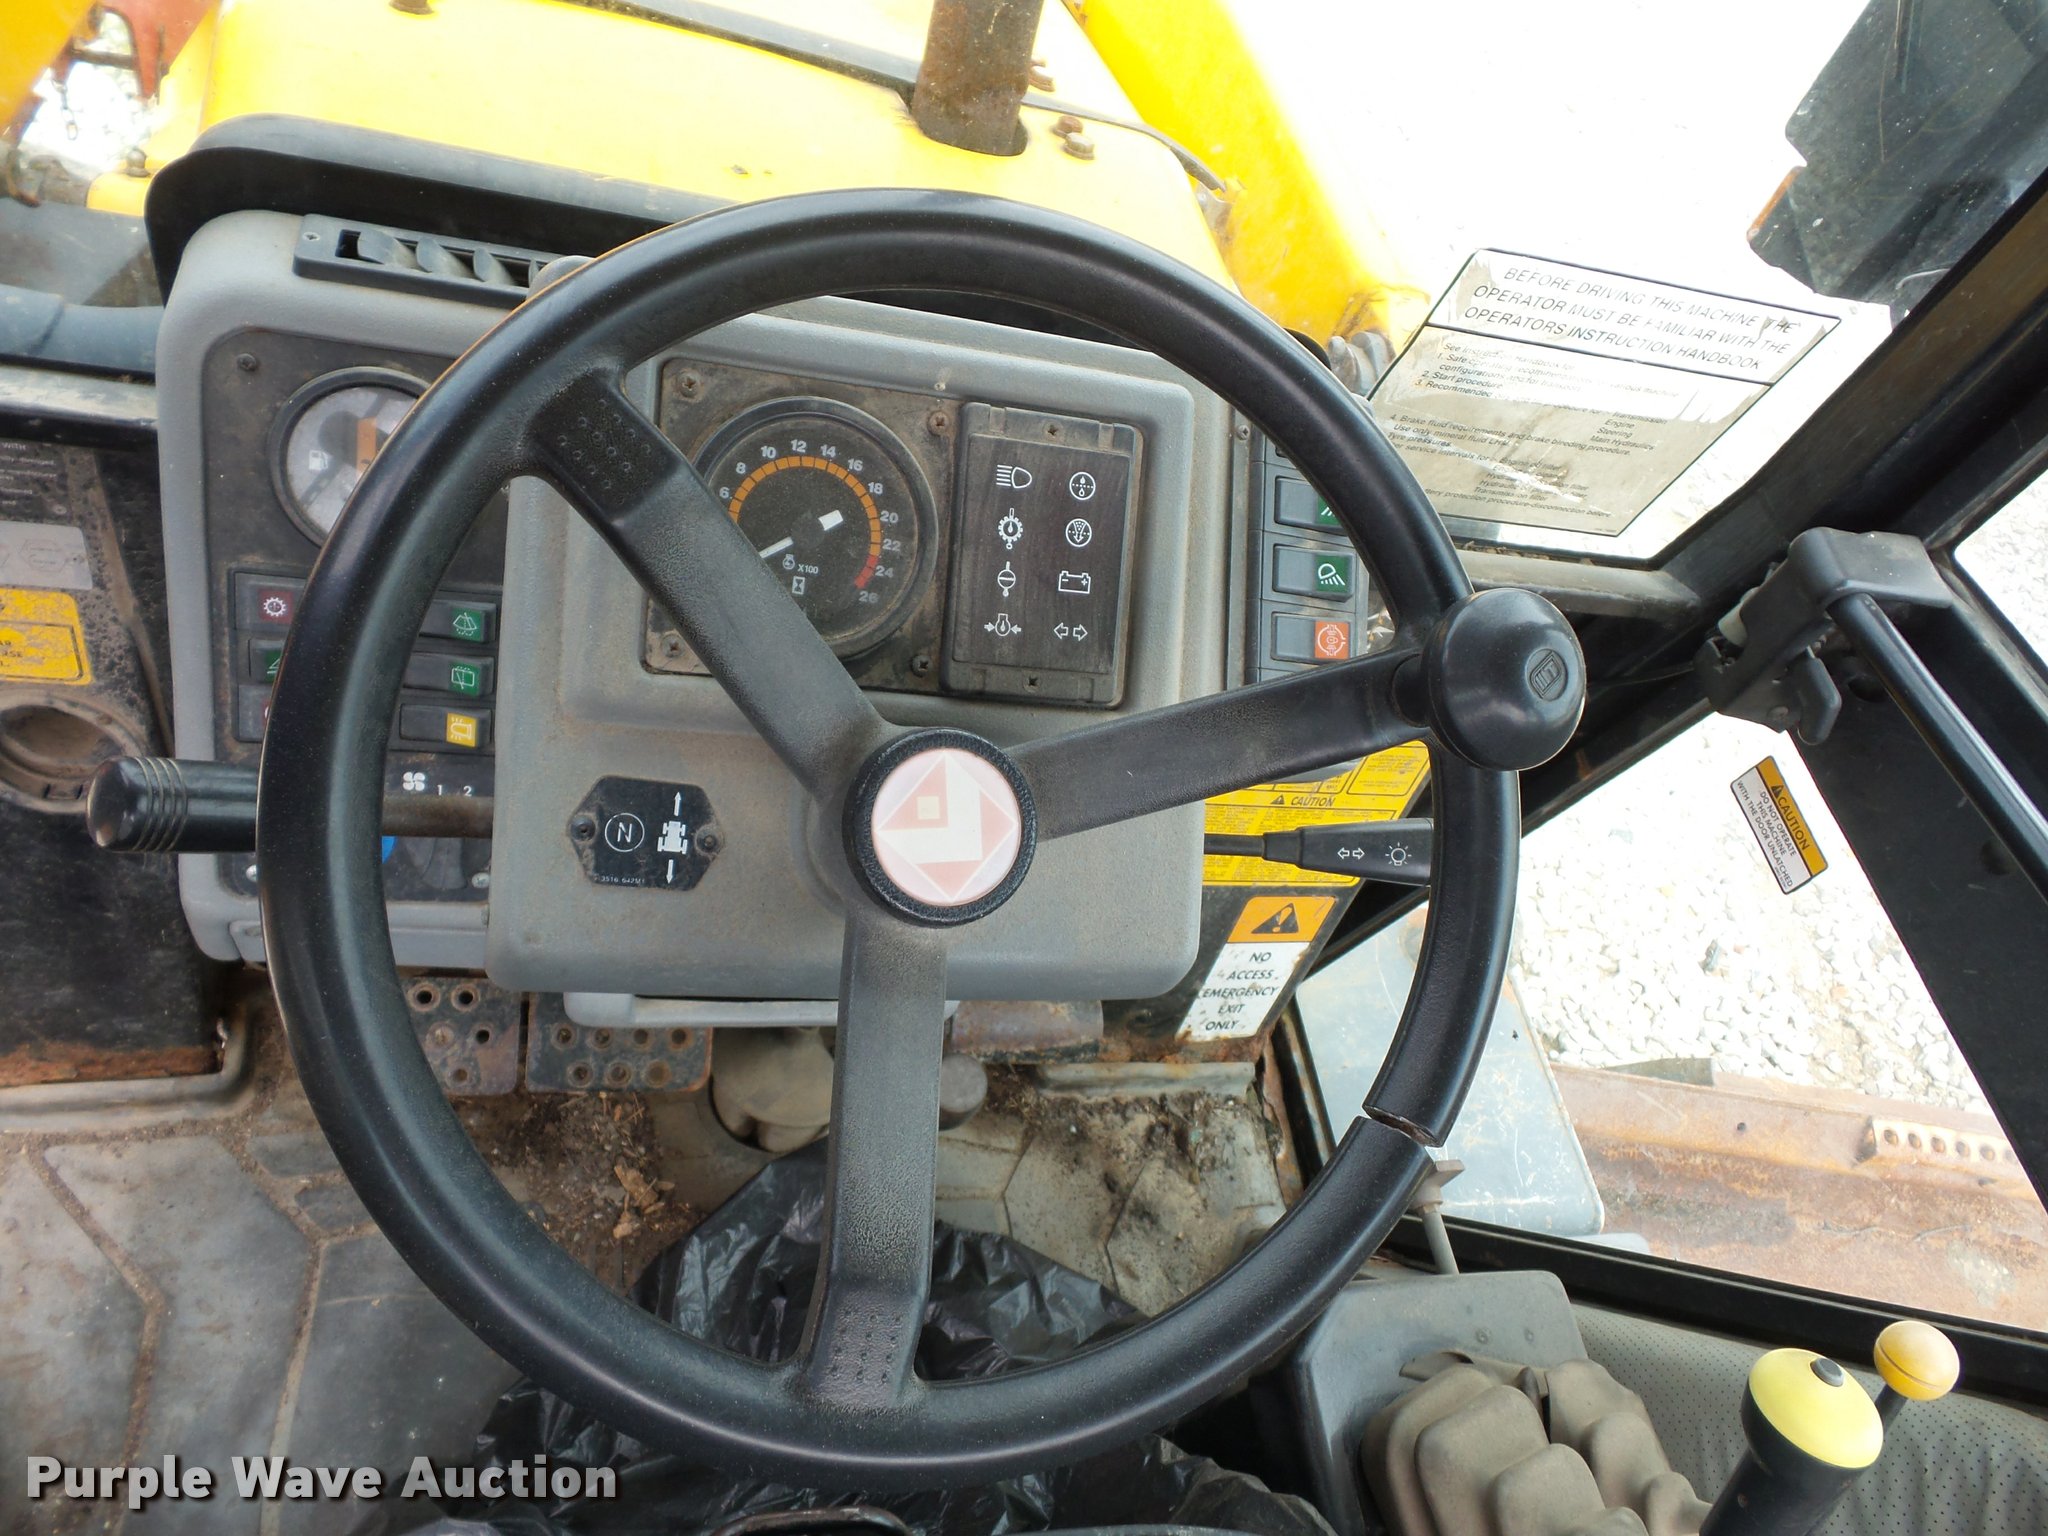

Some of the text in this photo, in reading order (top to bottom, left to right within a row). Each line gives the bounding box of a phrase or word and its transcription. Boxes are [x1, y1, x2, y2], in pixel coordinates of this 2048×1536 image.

[1504, 267, 1799, 334] BEFORE DRIVING THIS MACHINE THE
[1473, 285, 1792, 355] OPERATOR MUST BE FAMILIAR WITH THE
[1464, 306, 1762, 370] OPERATORS INSTRUCTION HANDBOOK
[1443, 342, 1462, 352] See
[1446, 354, 1468, 364] Safe
[1432, 371, 1456, 382] Start
[1455, 376, 1504, 390] procedure
[1400, 415, 1427, 425] Brake
[1448, 423, 1507, 438] requirements
[1604, 418, 1636, 430] Engine
[1393, 423, 1411, 432] Use
[1412, 427, 1431, 437] only
[1433, 430, 1467, 441] mineral
[1597, 426, 1633, 439] Steering
[761, 445, 777, 459] 10
[791, 439, 807, 453] 12
[820, 444, 837, 458] 14
[1406, 444, 1438, 454] service
[1438, 449, 1475, 460] intervals
[735, 462, 746, 474] 8
[847, 458, 863, 472] 16
[719, 487, 730, 499] 6
[868, 482, 884, 495] 18
[880, 511, 899, 524] 20
[883, 539, 900, 551] 22
[875, 565, 894, 578] 24
[858, 591, 879, 603] 26
[437, 784, 473, 797] 1 2
[1290, 795, 1336, 807] CAUTION
[1756, 801, 1768, 821] THIS
[1765, 820, 1786, 855] MACHINE
[1760, 791, 1770, 805] DO
[1766, 803, 1779, 822] NOT
[1776, 822, 1797, 857] OPERATE
[1778, 796, 1810, 850] CAUTION
[617, 822, 633, 843] N
[1737, 780, 1750, 801] WITH
[1747, 801, 1758, 816] THE
[1755, 816, 1769, 841] DOOR
[1767, 840, 1794, 887] UNLATCHED
[1249, 952, 1272, 963] NO
[1226, 969, 1275, 980] ACCESS
[1202, 986, 1280, 999] EMERGENCY
[1217, 1004, 1246, 1014] EXIT
[1205, 1020, 1240, 1031] ONLY
